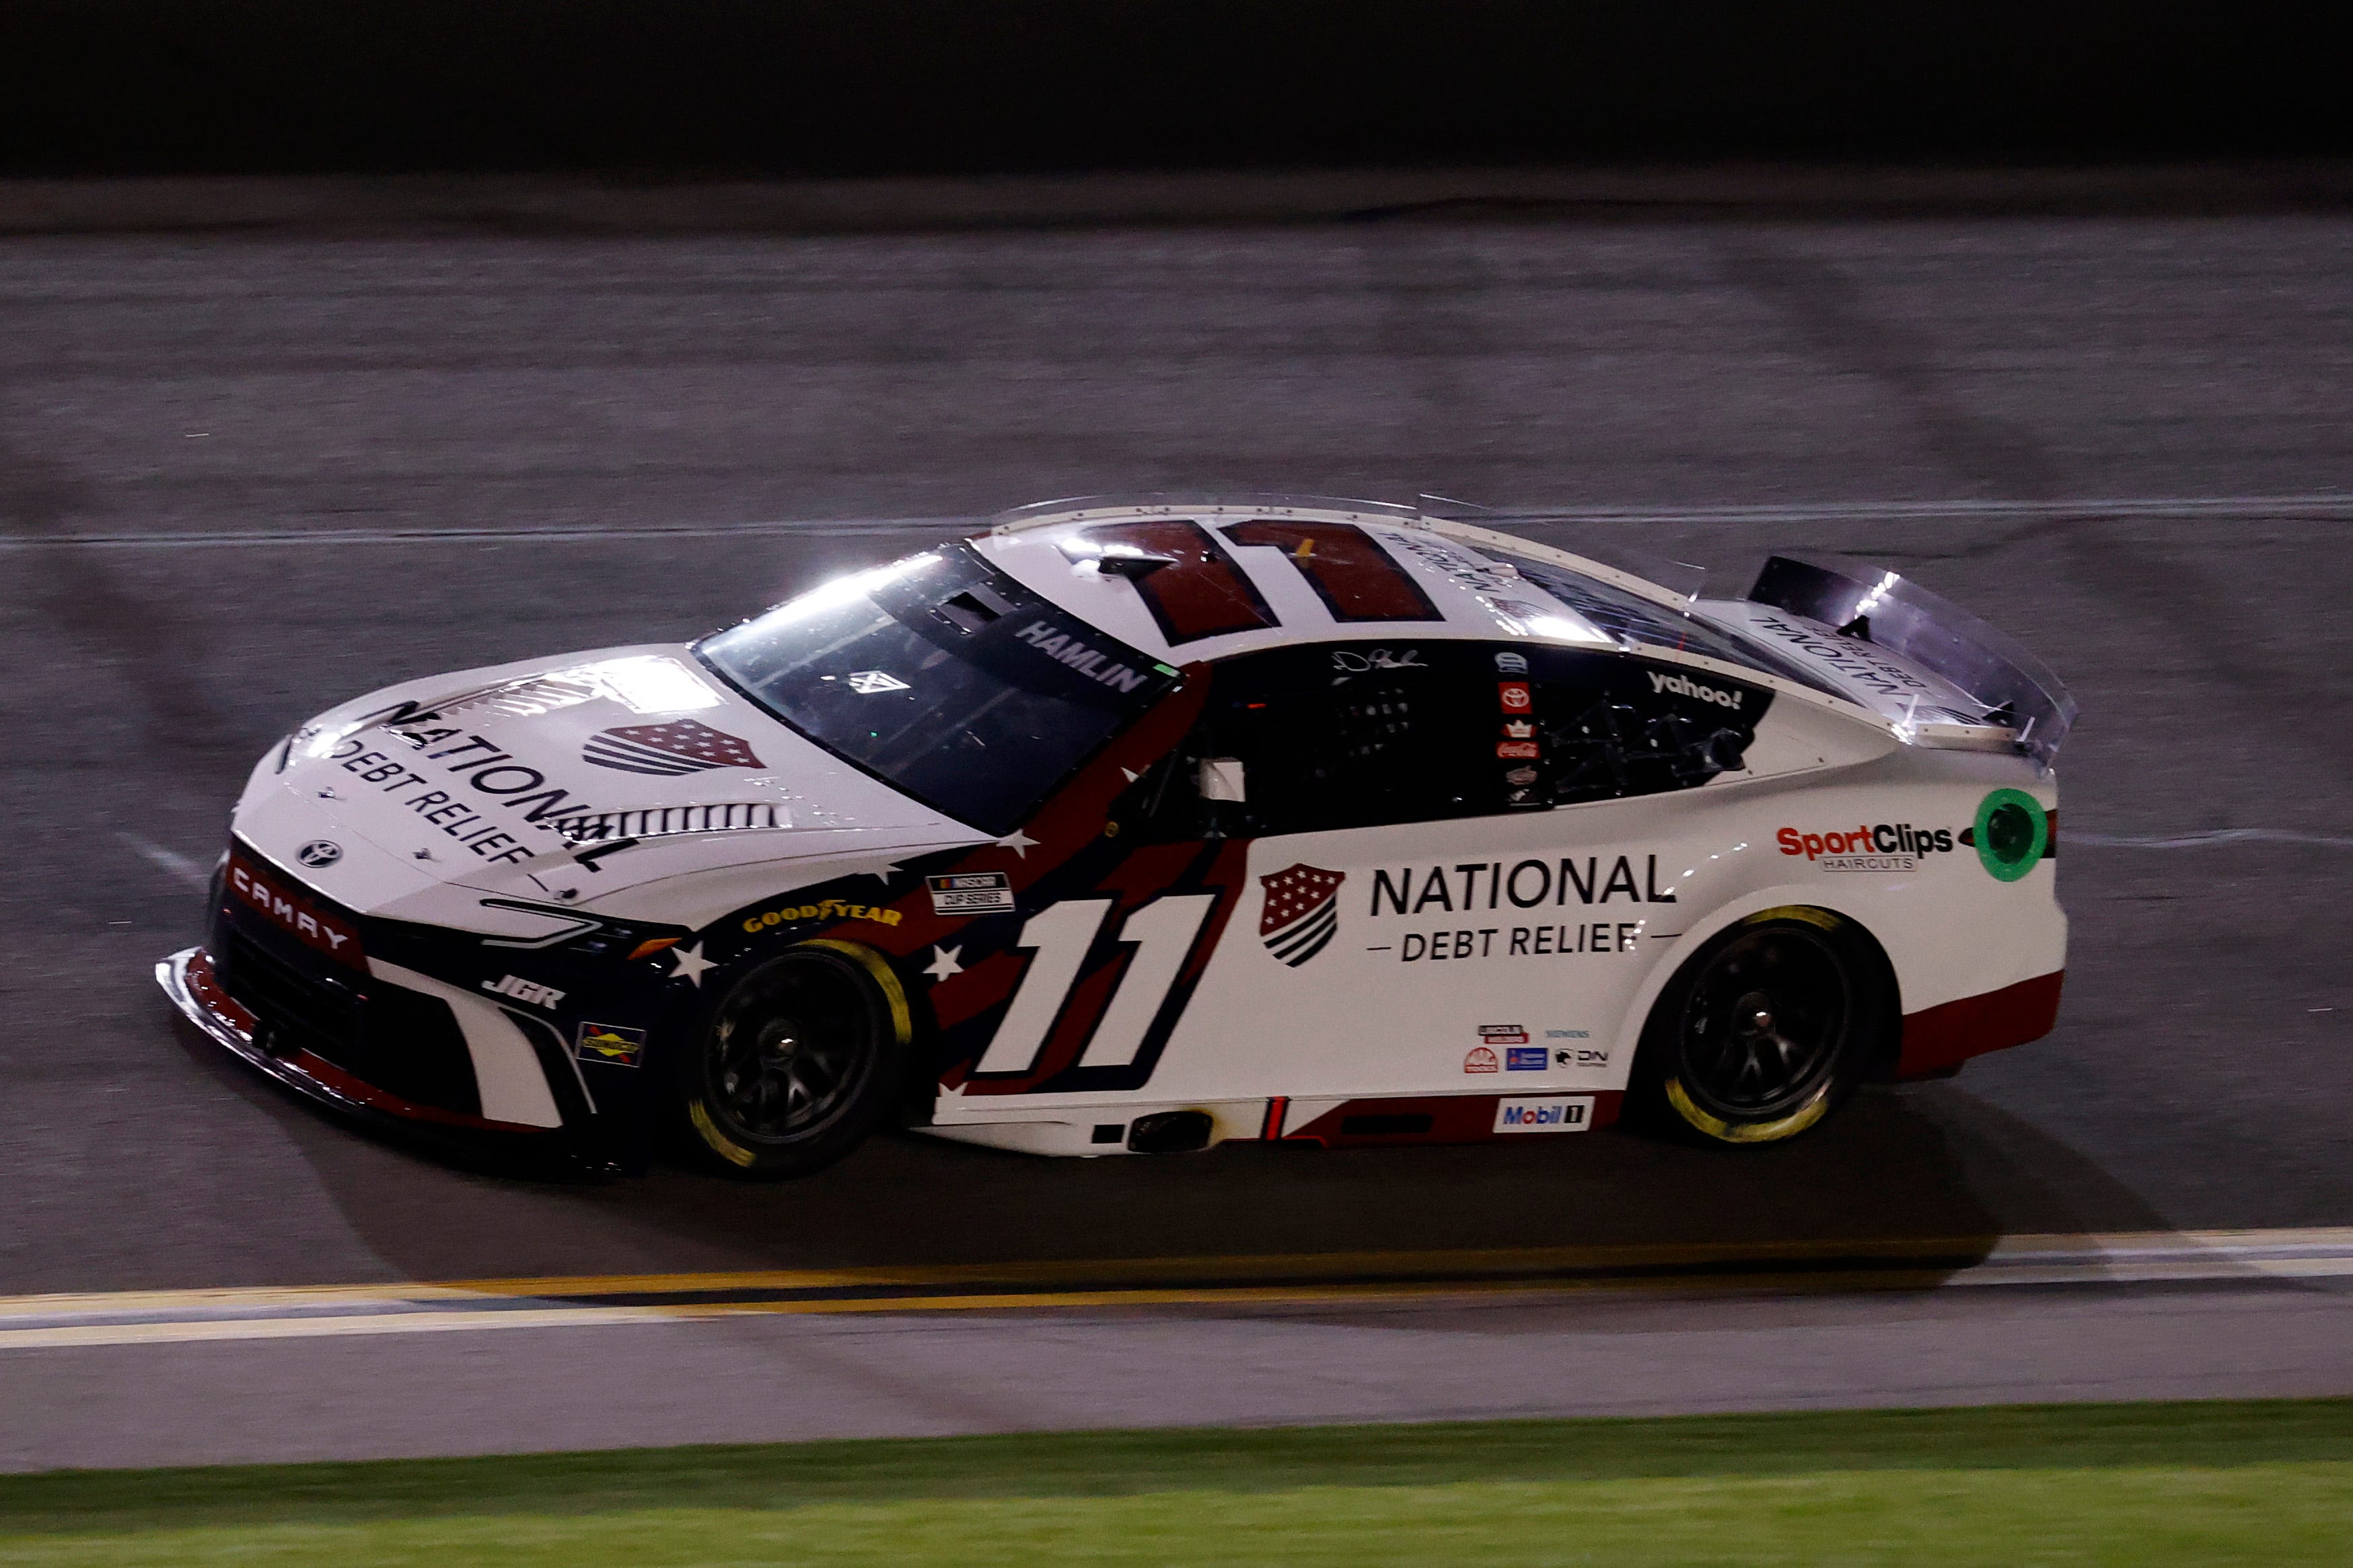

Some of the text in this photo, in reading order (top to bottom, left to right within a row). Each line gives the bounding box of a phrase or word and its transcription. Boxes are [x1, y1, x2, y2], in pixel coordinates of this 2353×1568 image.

[1015, 620, 1147, 694] HAMLIN
[1749, 616, 1912, 697] NATIONAL
[1866, 659, 1926, 689] DEBT
[1647, 671, 1743, 710] yahoo!
[331, 739, 536, 864] DEBT RELIEF
[1776, 822, 1954, 861] SportClips
[1823, 856, 1915, 870] HAIRCUTS
[1371, 854, 1677, 917] NATIONAL
[233, 866, 348, 950] CAMRY
[1402, 923, 1637, 962] DEBT RELIEF
[481, 974, 567, 1010] JGR
[975, 894, 1217, 1072] 11
[1503, 1105, 1562, 1124] Mobil
